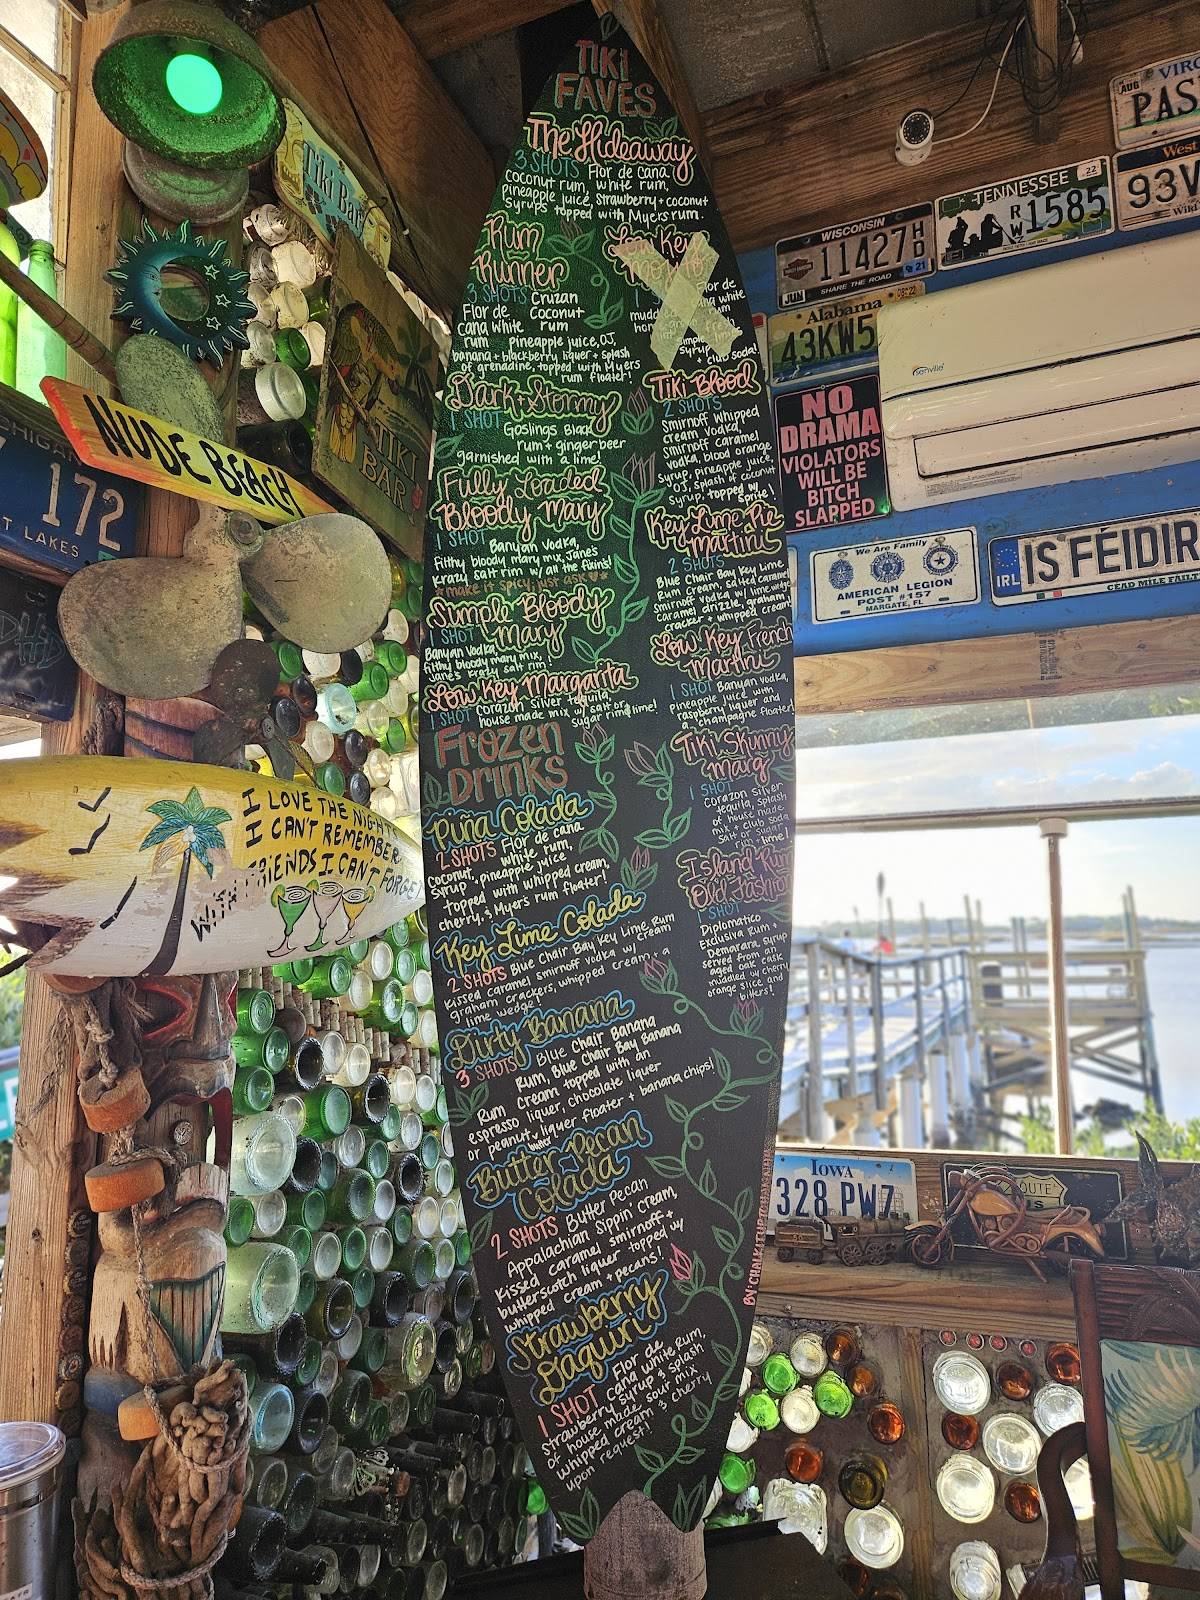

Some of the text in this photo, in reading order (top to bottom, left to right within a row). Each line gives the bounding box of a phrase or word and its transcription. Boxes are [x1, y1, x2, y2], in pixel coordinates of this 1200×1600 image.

[576, 40, 629, 81] TIKI
[554, 73, 657, 116] FAVES
[1121, 80, 1140, 95] AUG
[527, 119, 694, 181] The Hideaway
[530, 152, 580, 178] SHOTS
[1163, 141, 1198, 158] West
[303, 139, 363, 231] Tiki Bar
[502, 184, 556, 202] pineapple
[974, 171, 1070, 204] TENNESSEE
[598, 208, 668, 230] with Myers
[1026, 188, 1107, 234] 1585
[484, 215, 540, 265] Rum
[821, 217, 886, 243] WISCONSIN
[472, 251, 565, 294] Runner
[821, 273, 892, 295] SHARE THE ROAD
[482, 285, 528, 304] SHOTS
[531, 292, 578, 306] Cruzan
[785, 290, 804, 305] JUN
[806, 299, 884, 325] Alabama
[509, 335, 564, 355] pineapple
[690, 361, 754, 395] Blood
[450, 374, 518, 416] Dark
[527, 379, 617, 432] Stormy
[679, 396, 722, 413] SHOTS
[802, 385, 854, 422] NO
[464, 411, 503, 429] SHOT
[503, 422, 557, 442] Goslings
[661, 411, 708, 433] Smirnoff
[780, 408, 881, 453] DRAMA
[83, 394, 306, 519] NUDE BEACH
[375, 417, 418, 484] TIKI
[457, 449, 552, 468] garnished with
[704, 441, 773, 462] blood orange
[782, 438, 882, 475] VIOLATORS
[359, 442, 405, 512] BAR
[445, 467, 603, 505] Fully Loaded
[797, 460, 868, 500] WILL BE
[42, 462, 125, 552] 172
[807, 481, 861, 508] BITCH
[436, 496, 532, 542] Bloody
[650, 503, 784, 547] Key Lime Pie
[795, 498, 876, 529] SLAPPED
[24, 526, 80, 558] LAKES
[449, 528, 488, 548] SHOT
[489, 538, 538, 555] Banyan
[856, 539, 928, 556] We Are Family
[656, 575, 681, 589] Blue
[685, 570, 714, 584] Chair
[716, 566, 735, 580] Bay
[682, 554, 725, 573] SHOTS
[1025, 541, 1061, 586] IS
[837, 578, 953, 602] AMERICAN LEGION
[996, 573, 1021, 589] IRL
[434, 587, 609, 633] Simple Bloody
[857, 590, 932, 607] POST #157
[865, 599, 924, 613] MARGATE, FL
[657, 622, 793, 660] Low Key French
[428, 664, 632, 712] Low Key Margarita
[434, 721, 565, 769] Frozen
[722, 727, 794, 761] Skinny
[242, 788, 261, 817] I
[267, 790, 314, 813] LOVE
[318, 798, 349, 820] THE
[701, 780, 733, 795] SHOT
[425, 793, 589, 851] Piña Colada
[245, 815, 400, 866] I CAN'T REMEMBER
[452, 842, 497, 867] SHOTS
[318, 852, 335, 877] I
[338, 852, 381, 887] CAN'T
[681, 850, 755, 882] Island
[443, 865, 571, 917] topped with whipped
[692, 878, 728, 908] Old
[435, 890, 642, 976] Key Lime Colada
[464, 966, 508, 989] SHOTS
[450, 997, 627, 1070] Dirty Banana
[475, 1056, 518, 1081] SHOTS
[469, 1118, 647, 1202] Butter Pecan
[518, 1153, 626, 1220] Colada
[776, 1177, 829, 1217] 328
[1004, 1179, 1056, 1195] OUTE
[509, 1216, 560, 1250] SHOTS
[508, 1233, 591, 1278] Appalachian
[511, 1277, 662, 1371] Strawberry
[550, 1384, 601, 1427] SHOT
[556, 1437, 610, 1481] whipped
[565, 1466, 596, 1492] upon
